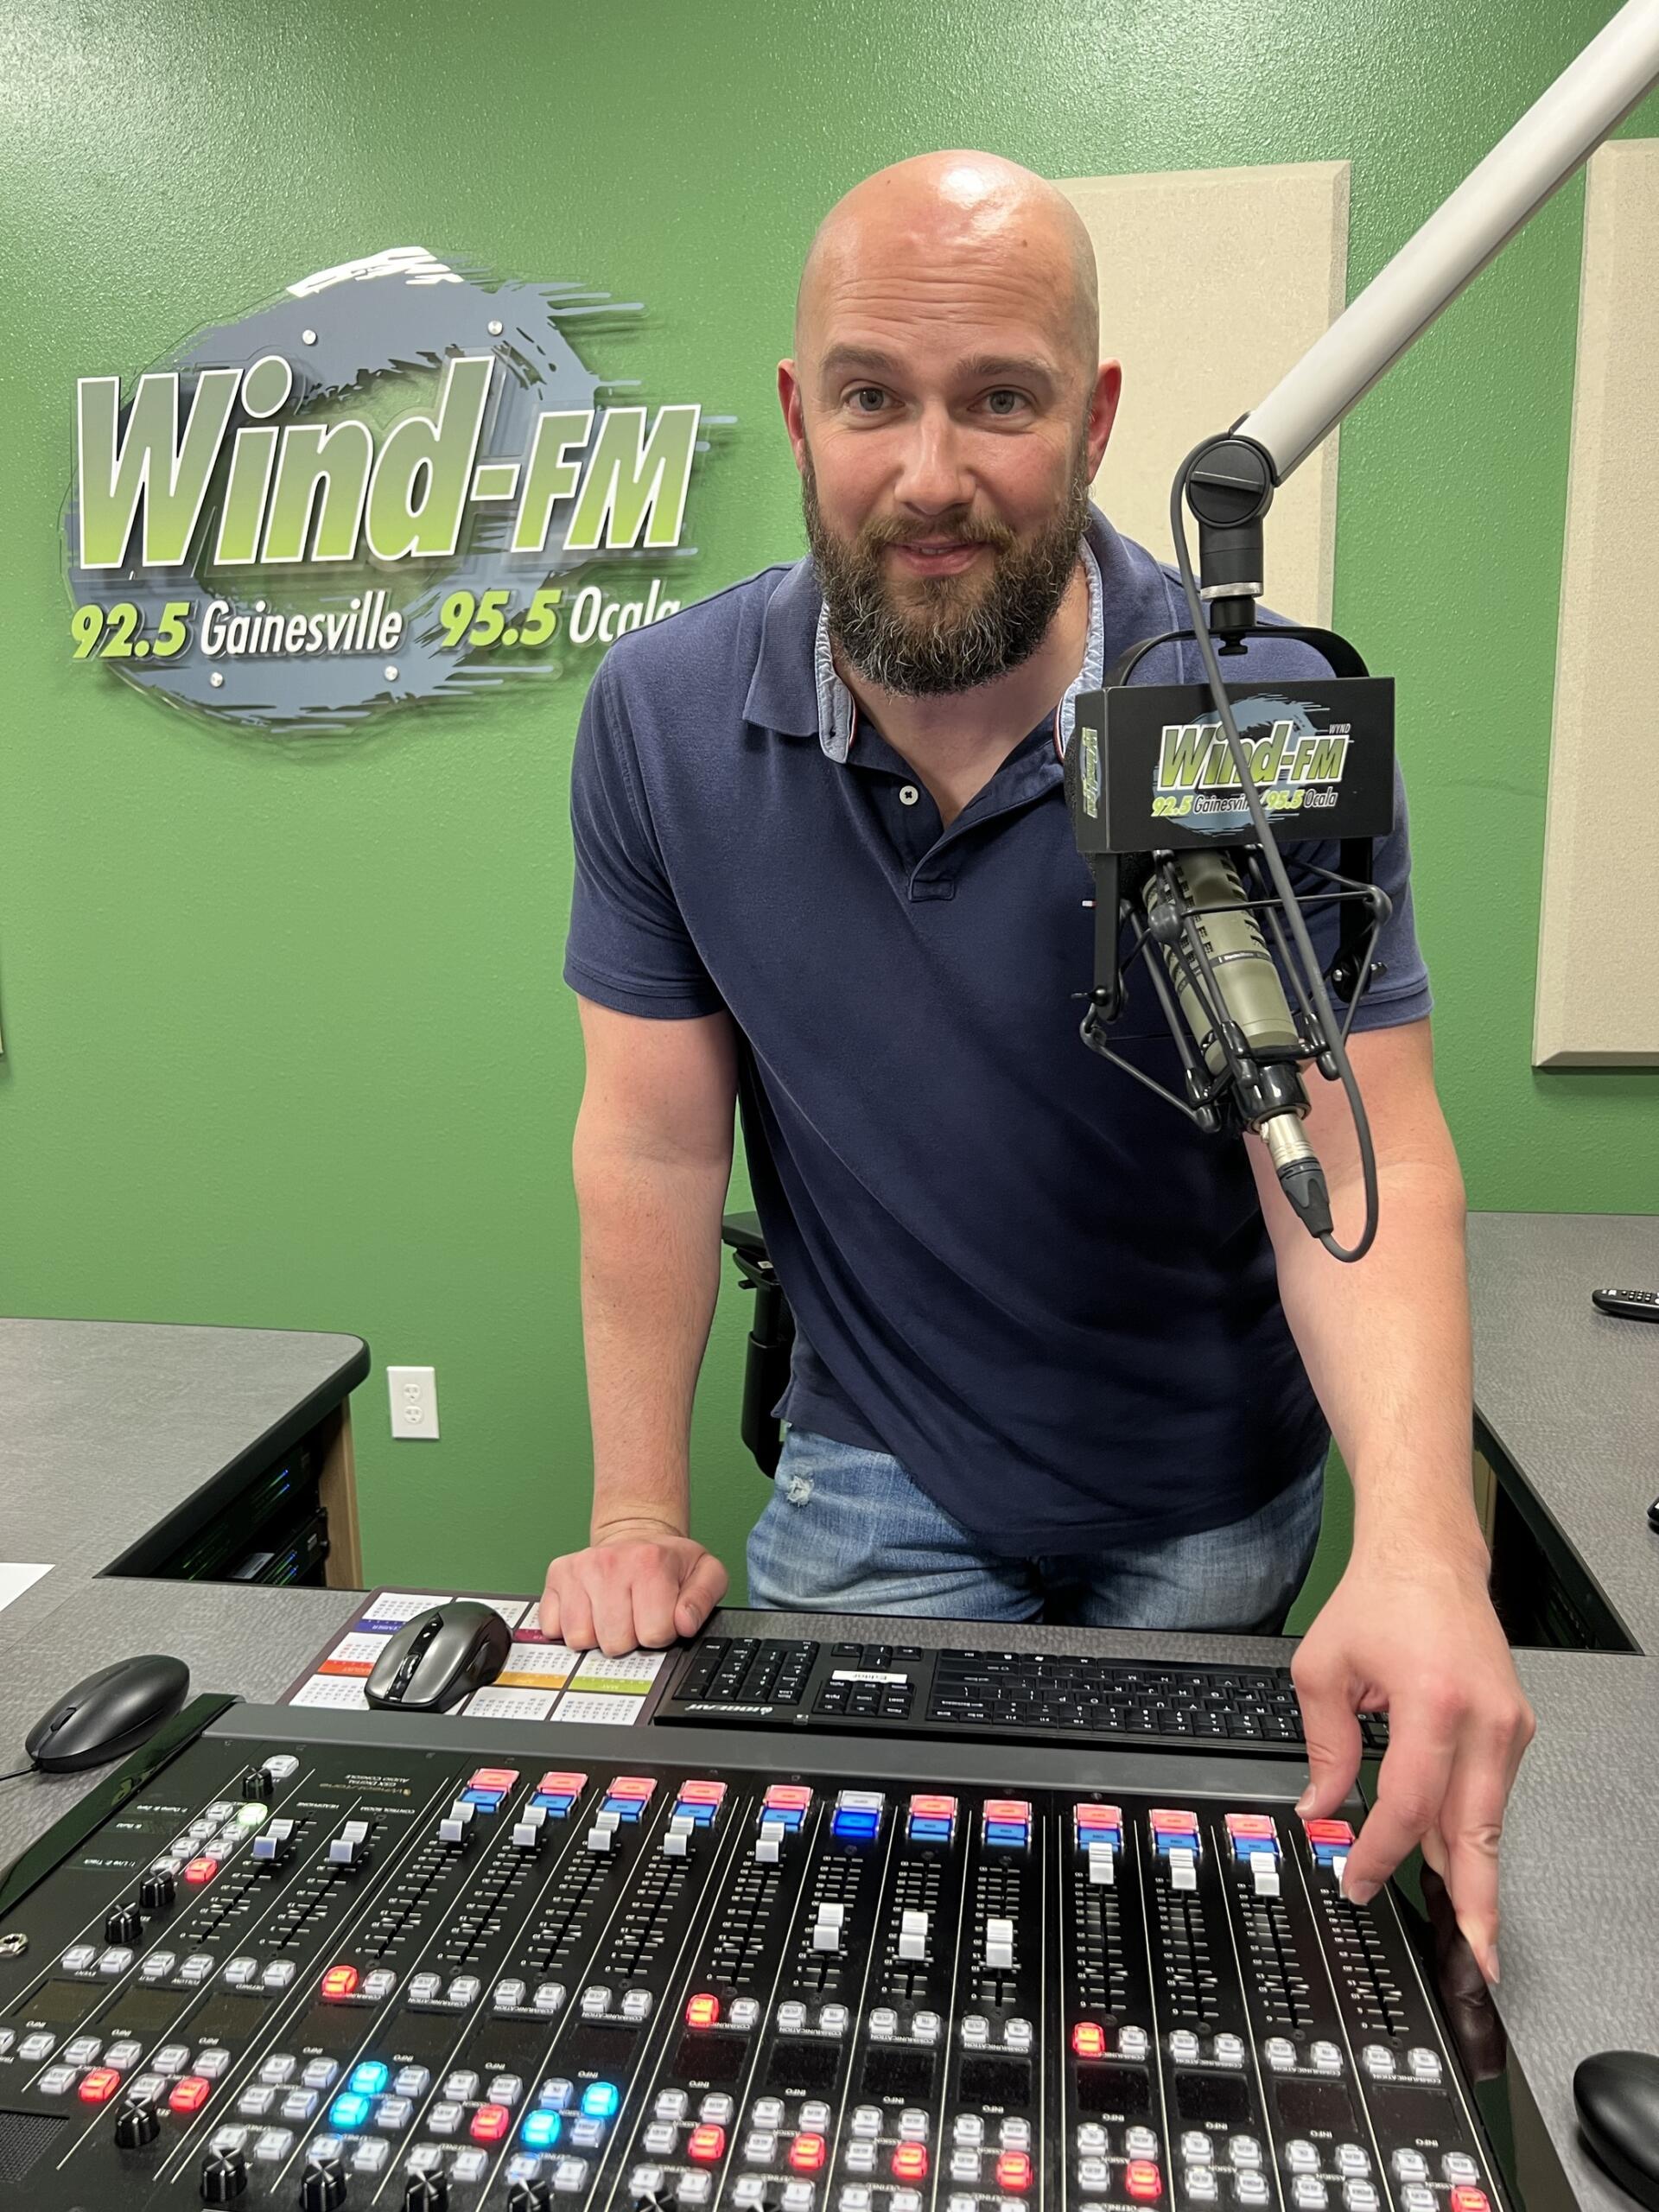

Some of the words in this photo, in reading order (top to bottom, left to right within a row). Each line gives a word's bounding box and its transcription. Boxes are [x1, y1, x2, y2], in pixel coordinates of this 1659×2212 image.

[77, 355, 702, 570] Wind-FM
[71, 602, 193, 659] 92.5
[200, 591, 404, 657] Gainesville
[440, 589, 564, 646] 95.5
[1329, 723, 1351, 734] WYND
[1157, 720, 1349, 791] Wind-FM
[1151, 795, 1194, 817] 92.5
[1193, 793, 1250, 814] Gainesvi
[1304, 786, 1339, 809] Ocala
[493, 2005, 554, 2013] COMMUNICATION
[582, 2012, 642, 2021] COMMUNICATION
[779, 2027, 842, 2036] COMMUNICATION
[871, 2034, 934, 2044] COMMUNICATION
[963, 2043, 1028, 2052] COMMUNICATION
